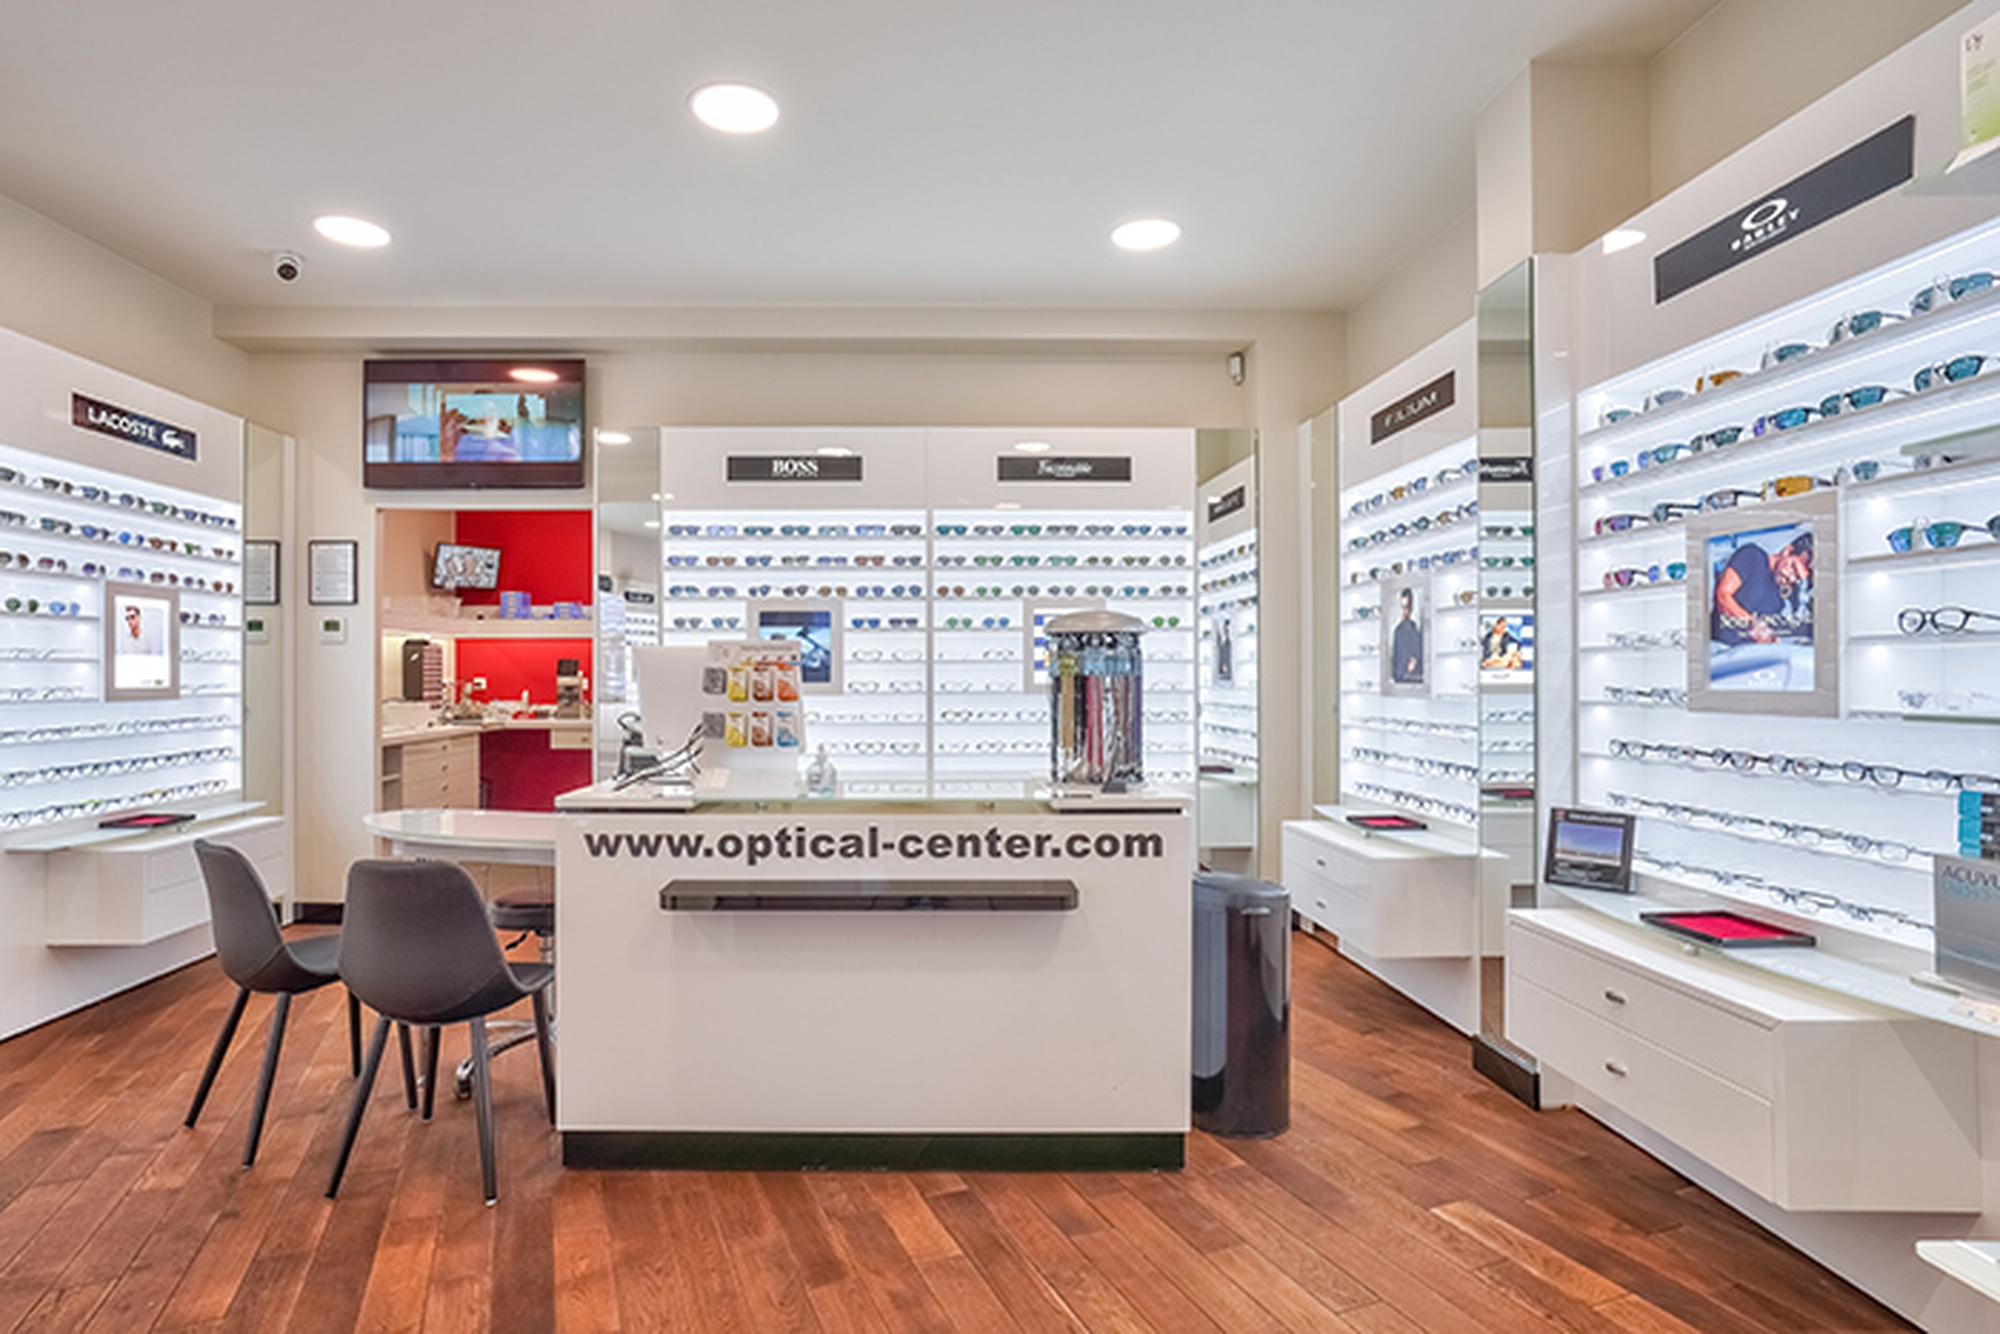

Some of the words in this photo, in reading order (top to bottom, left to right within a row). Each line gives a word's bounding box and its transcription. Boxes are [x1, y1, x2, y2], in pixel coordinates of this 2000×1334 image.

[87, 406, 157, 441] LACOSTE
[772, 459, 818, 473] BOSS
[583, 826, 1164, 866] www.optical-center.com
